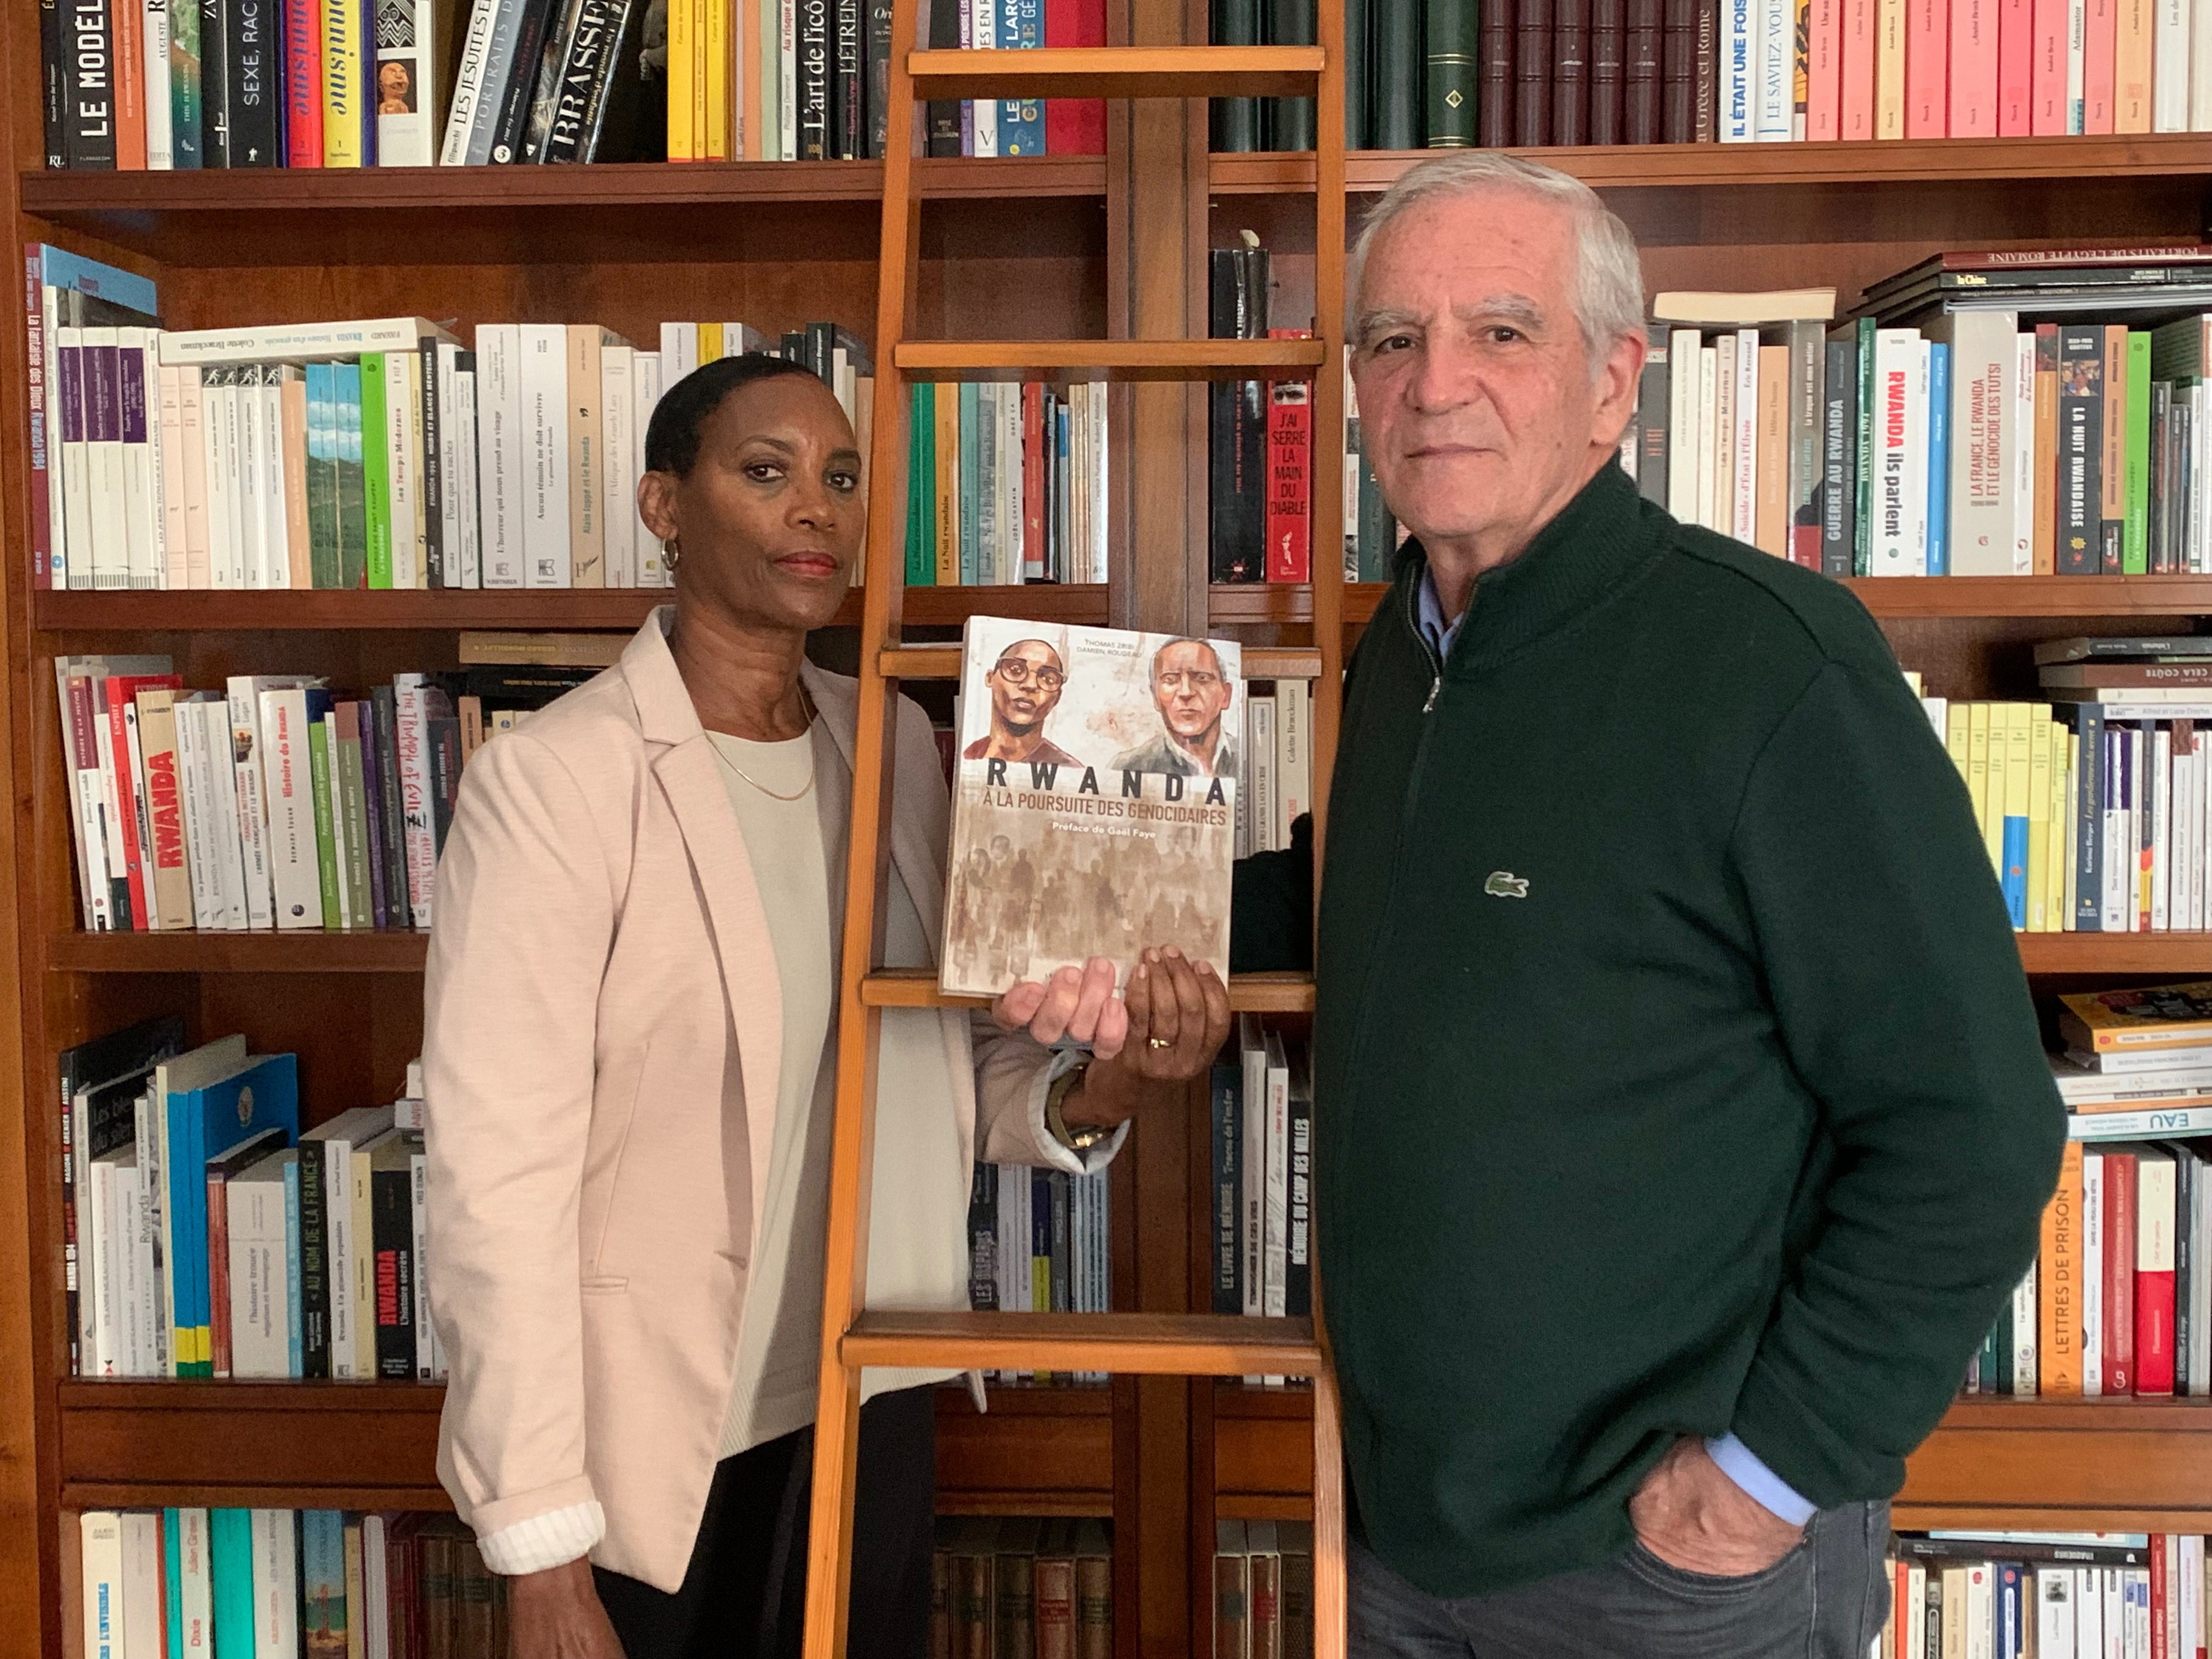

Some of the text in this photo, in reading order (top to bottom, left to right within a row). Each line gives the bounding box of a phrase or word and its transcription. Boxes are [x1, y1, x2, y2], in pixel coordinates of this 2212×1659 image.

[158, 21, 167, 60] AUGUSTE
[782, 7, 793, 52] Au risque
[961, 13, 970, 43] PRENDRE
[2073, 6, 2083, 51] Adamastor
[1733, 38, 1747, 72] UNE
[242, 49, 261, 105] SEXE,
[475, 24, 509, 129] PORTRAITS
[803, 48, 825, 129] L'art de
[454, 95, 471, 125] LES
[1729, 75, 1746, 119] ÉTAIT
[1766, 101, 1781, 119] LE
[80, 101, 108, 136] LE
[1733, 123, 1746, 137] IL
[447, 130, 461, 163] filipacchi
[1987, 251, 2045, 263] ROMAINE
[27, 314, 41, 325] La
[29, 327, 43, 366] fantaisie
[180, 331, 400, 352] FAYARD Colette Braeckman
[30, 368, 42, 384] des
[30, 386, 43, 410] Dieux
[427, 422, 434, 431] ET
[493, 410, 503, 436] visage
[1971, 379, 1985, 496] LA FRANCE, LE RWANDA
[1984, 364, 2001, 496] ET LE GÉNOCIDE DES TUTSI
[394, 408, 405, 503] Les Temps Modernes
[427, 432, 435, 454] NOIRS
[495, 438, 501, 448] au
[537, 449, 543, 459] ne
[580, 436, 590, 468] Rwanda
[1282, 449, 1295, 462] LA
[1884, 371, 1906, 537] RWANDA ils parlent
[494, 450, 504, 475] prend
[535, 460, 545, 490] témoin
[1274, 465, 1302, 480] MAIN
[1827, 399, 1845, 541] GUERRE AU RWANDA
[2070, 407, 2085, 528] LA NUIT RWANDAISE
[444, 441, 456, 520] Pour que tu saches
[1280, 483, 1296, 498] DU
[495, 498, 505, 510] qui
[535, 493, 545, 520] Aucun
[1271, 501, 1307, 515] DIABLE
[1740, 501, 1750, 532] Suicide
[495, 511, 505, 554] L'horreur
[1076, 646, 1105, 654] DAMIEN
[1084, 638, 1116, 647] THOMAS
[2145, 668, 2208, 679] CELA COÛTE
[231, 696, 241, 723] Bernard
[241, 702, 251, 723] Lugan
[1286, 735, 1295, 763] Colette
[279, 743, 293, 798] Histoire du
[986, 758, 1227, 806] RWANDA
[148, 750, 183, 869] RWANDA
[996, 793, 1013, 808] LA
[1018, 794, 1093, 814] POURSUITE
[1097, 800, 1124, 817] DES
[1127, 800, 1227, 826] GÉNOCIDAIRES
[1052, 822, 1090, 833] Préface
[1091, 825, 1104, 834] de
[1132, 828, 1156, 839] Faye
[2150, 1112, 2189, 1129] EAU
[1293, 1155, 1309, 1173] DES
[138, 1194, 151, 1244] Rwanda
[302, 1161, 319, 1289] AU NOM DE LA FRANCE
[65, 1244, 77, 1291] RWANDA 1994
[2055, 1189, 2070, 1355] LETTRES DE PRISON
[377, 1250, 398, 1325] RWANDA
[1222, 1277, 1234, 1289] LE
[398, 1286, 409, 1325] L'histoire
[188, 1548, 199, 1576] Julien
[190, 1618, 201, 1647] Dixie
